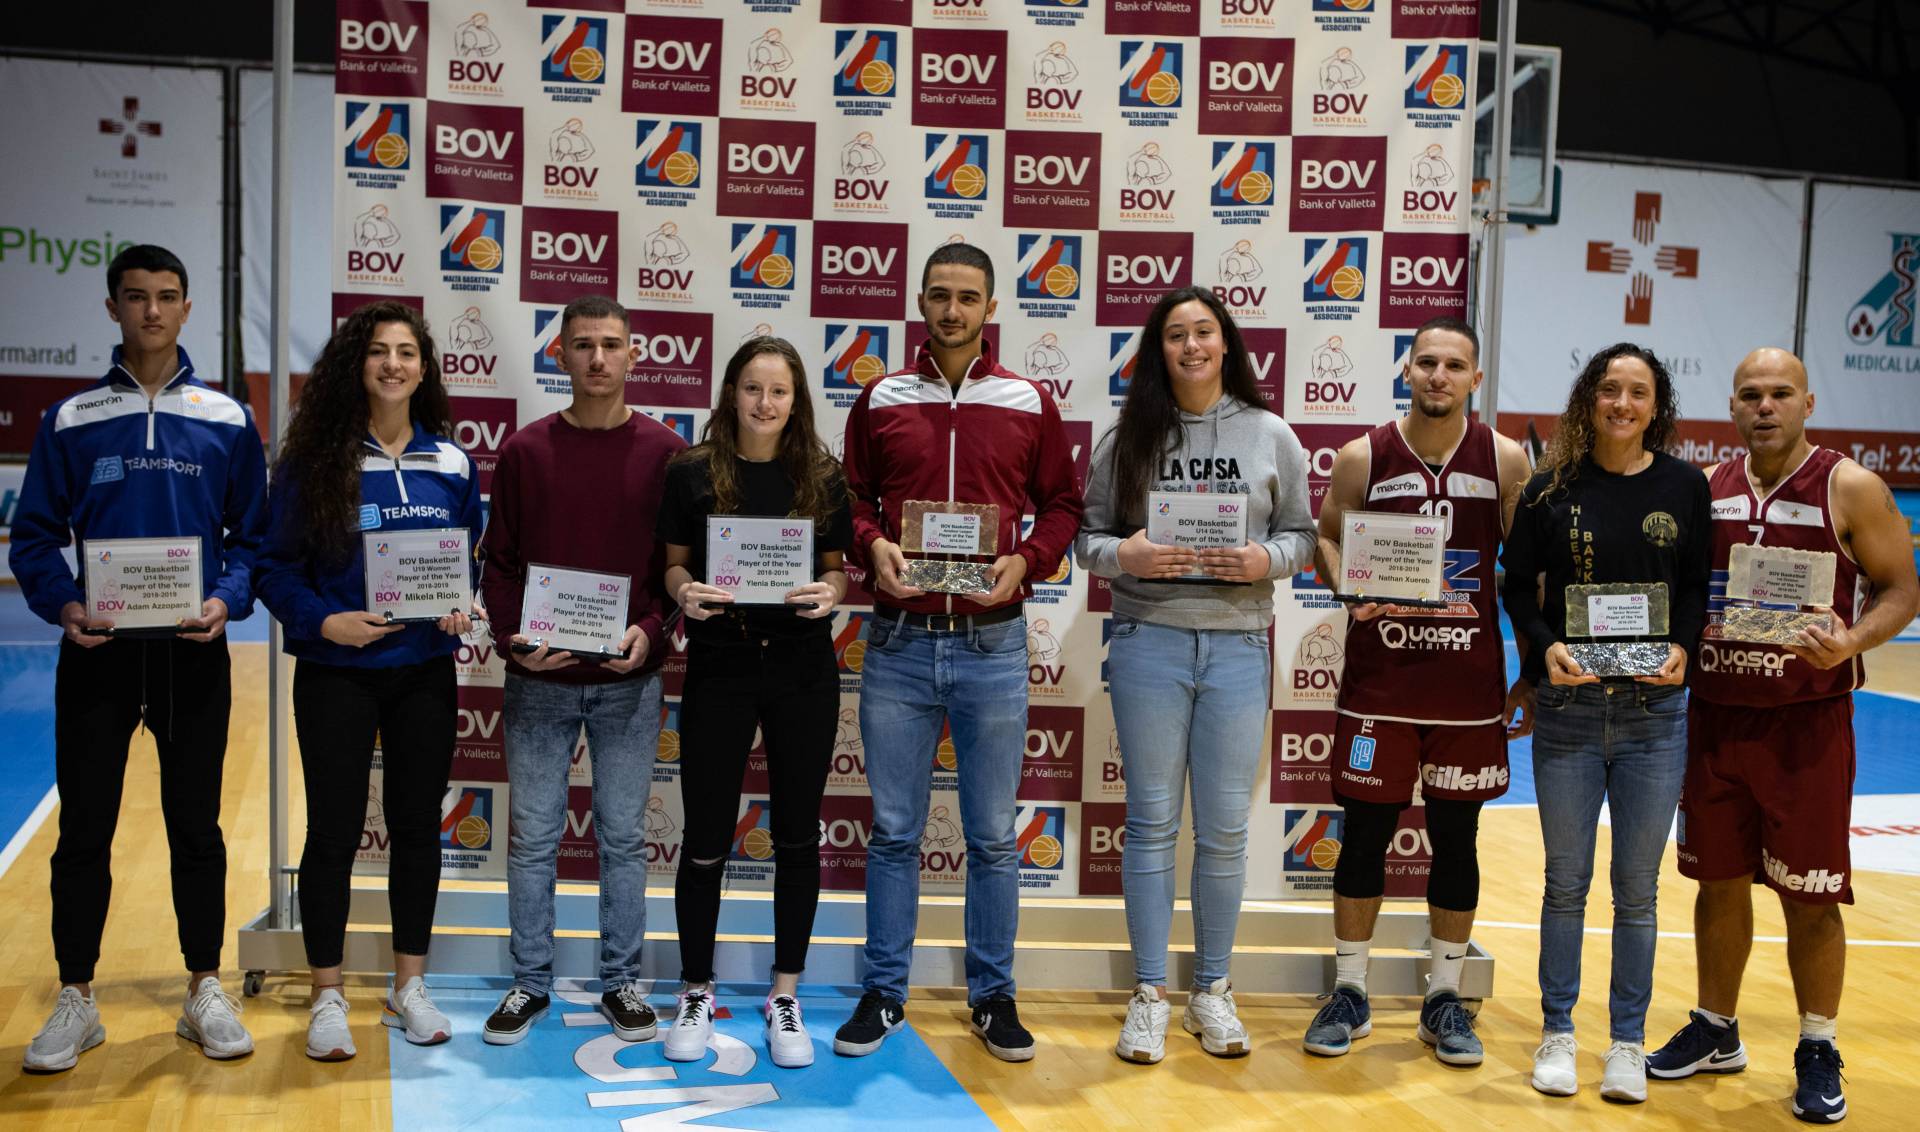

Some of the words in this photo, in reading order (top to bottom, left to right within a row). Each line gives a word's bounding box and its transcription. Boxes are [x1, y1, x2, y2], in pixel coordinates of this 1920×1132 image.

[340, 20, 418, 52] BOV
[340, 60, 365, 72] Bank
[367, 61, 378, 72] of
[379, 62, 418, 74] Valletta
[449, 60, 504, 83] BOV
[920, 53, 996, 84] BOV
[449, 84, 504, 92] BASKETBALL
[544, 86, 562, 95] MALTA
[564, 88, 601, 96] BASKETBALL
[920, 93, 944, 104] Bank
[946, 94, 958, 105] of
[959, 95, 996, 106] Valletta
[1302, 160, 1375, 189] BOV
[834, 179, 888, 200] BOV
[1120, 189, 1174, 210] BOV
[1300, 198, 1321, 209] Bank
[1324, 198, 1337, 209] of
[1339, 198, 1375, 209] Valletta
[834, 202, 888, 210] BASKETBALL
[530, 231, 608, 262] BOV
[348, 251, 404, 273] BOV
[348, 274, 404, 283] BASKETBALL
[443, 275, 461, 283] MALTA
[463, 276, 499, 284] BASKETBALL
[530, 270, 554, 281] Bank
[557, 271, 569, 283] of
[570, 273, 608, 284] Valletta
[0, 343, 76, 366] rmarrad
[1666, 358, 1702, 375] MES
[1844, 354, 1902, 372] MEDICAL
[1905, 356, 1920, 373] LA
[891, 384, 924, 392] macron
[1305, 382, 1357, 403] BOV
[76, 396, 122, 412] macron
[1851, 444, 1892, 472] Tel:
[1896, 445, 1920, 472] 23
[124, 457, 202, 478] TEAMSPORT
[1159, 459, 1184, 480] LA
[1190, 458, 1241, 480] CASA
[1377, 482, 1418, 494] macron
[1712, 506, 1741, 514] acron
[1415, 527, 1436, 535] BOV
[1748, 524, 1764, 546] 7
[440, 540, 460, 548] BOV
[1393, 540, 1433, 548] Basketball
[168, 549, 190, 557] BOV
[1584, 531, 1594, 583] BASK
[419, 556, 460, 565] Basketball
[1348, 569, 1373, 579] BOV
[716, 576, 741, 585] BOV
[121, 583, 145, 591] Player
[599, 583, 620, 592] BOV
[376, 592, 401, 602] BOV
[577, 595, 617, 606] Basketball
[1441, 593, 1470, 602] ONICS
[97, 601, 125, 611] BOV
[152, 602, 190, 610] Azzopardi
[554, 608, 575, 617] Player
[530, 620, 555, 631] BOV
[559, 627, 588, 636] Matthew
[590, 632, 612, 640] Attard
[1378, 620, 1480, 648] Quasar
[1409, 642, 1471, 650] LIMITED
[1700, 642, 1796, 672] Quasar
[1720, 666, 1784, 677] LIMITED
[1362, 719, 1374, 734] TE
[1035, 768, 1072, 778] Valletta
[1342, 770, 1382, 786] macron
[1422, 764, 1508, 791] Gillette
[451, 854, 487, 862] BASKETBALL
[1678, 852, 1698, 864] cron
